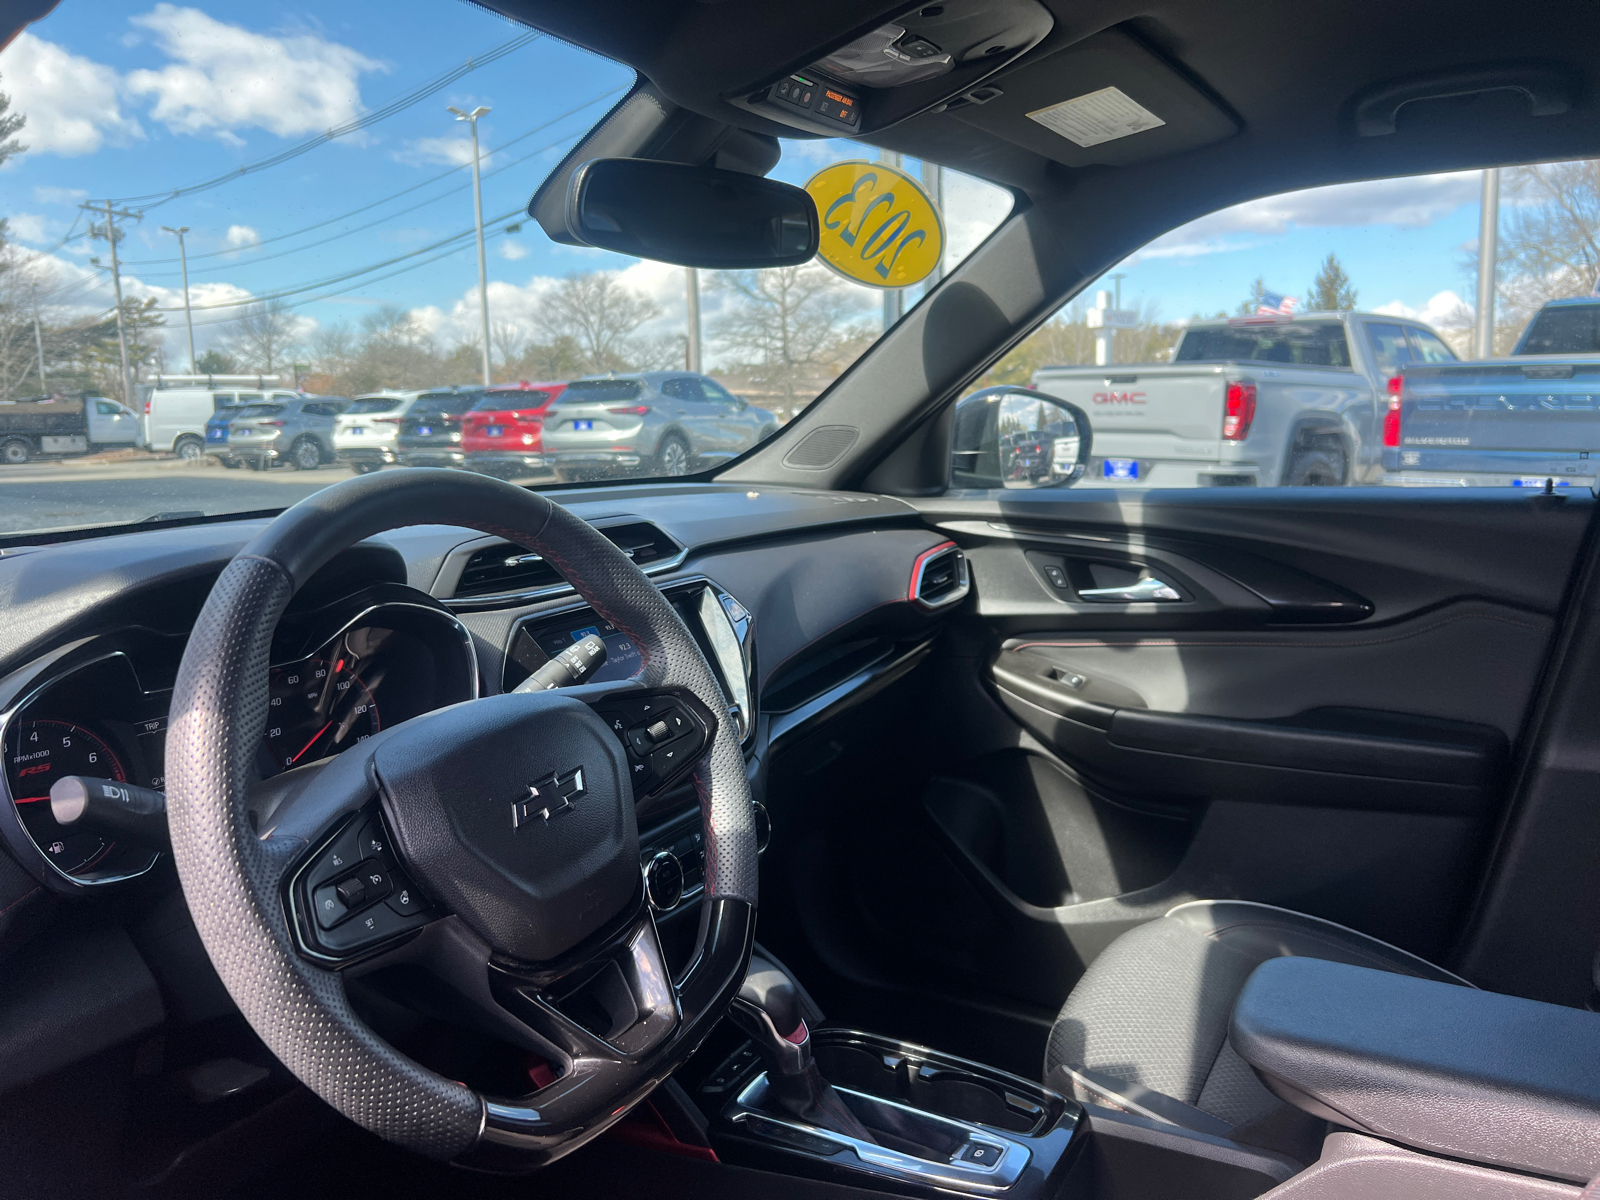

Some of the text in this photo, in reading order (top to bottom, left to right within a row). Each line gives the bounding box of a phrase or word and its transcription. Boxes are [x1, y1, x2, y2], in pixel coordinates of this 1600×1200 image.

[1092, 391, 1148, 405] GMC
[589, 646, 600, 656] REAR
[618, 642, 632, 652] 92.3
[610, 654, 626, 664] Taylor
[315, 669, 326, 678] 80
[287, 675, 299, 685] 60
[337, 680, 351, 690] 100
[270, 697, 282, 706] 40
[354, 704, 367, 714] 120
[144, 721, 160, 731] TRIP
[30, 731, 39, 742] 4
[270, 727, 281, 738] 20
[62, 736, 71, 748] 5
[89, 752, 97, 763] 6
[286, 757, 292, 766] 0
[19, 763, 51, 777] RS
